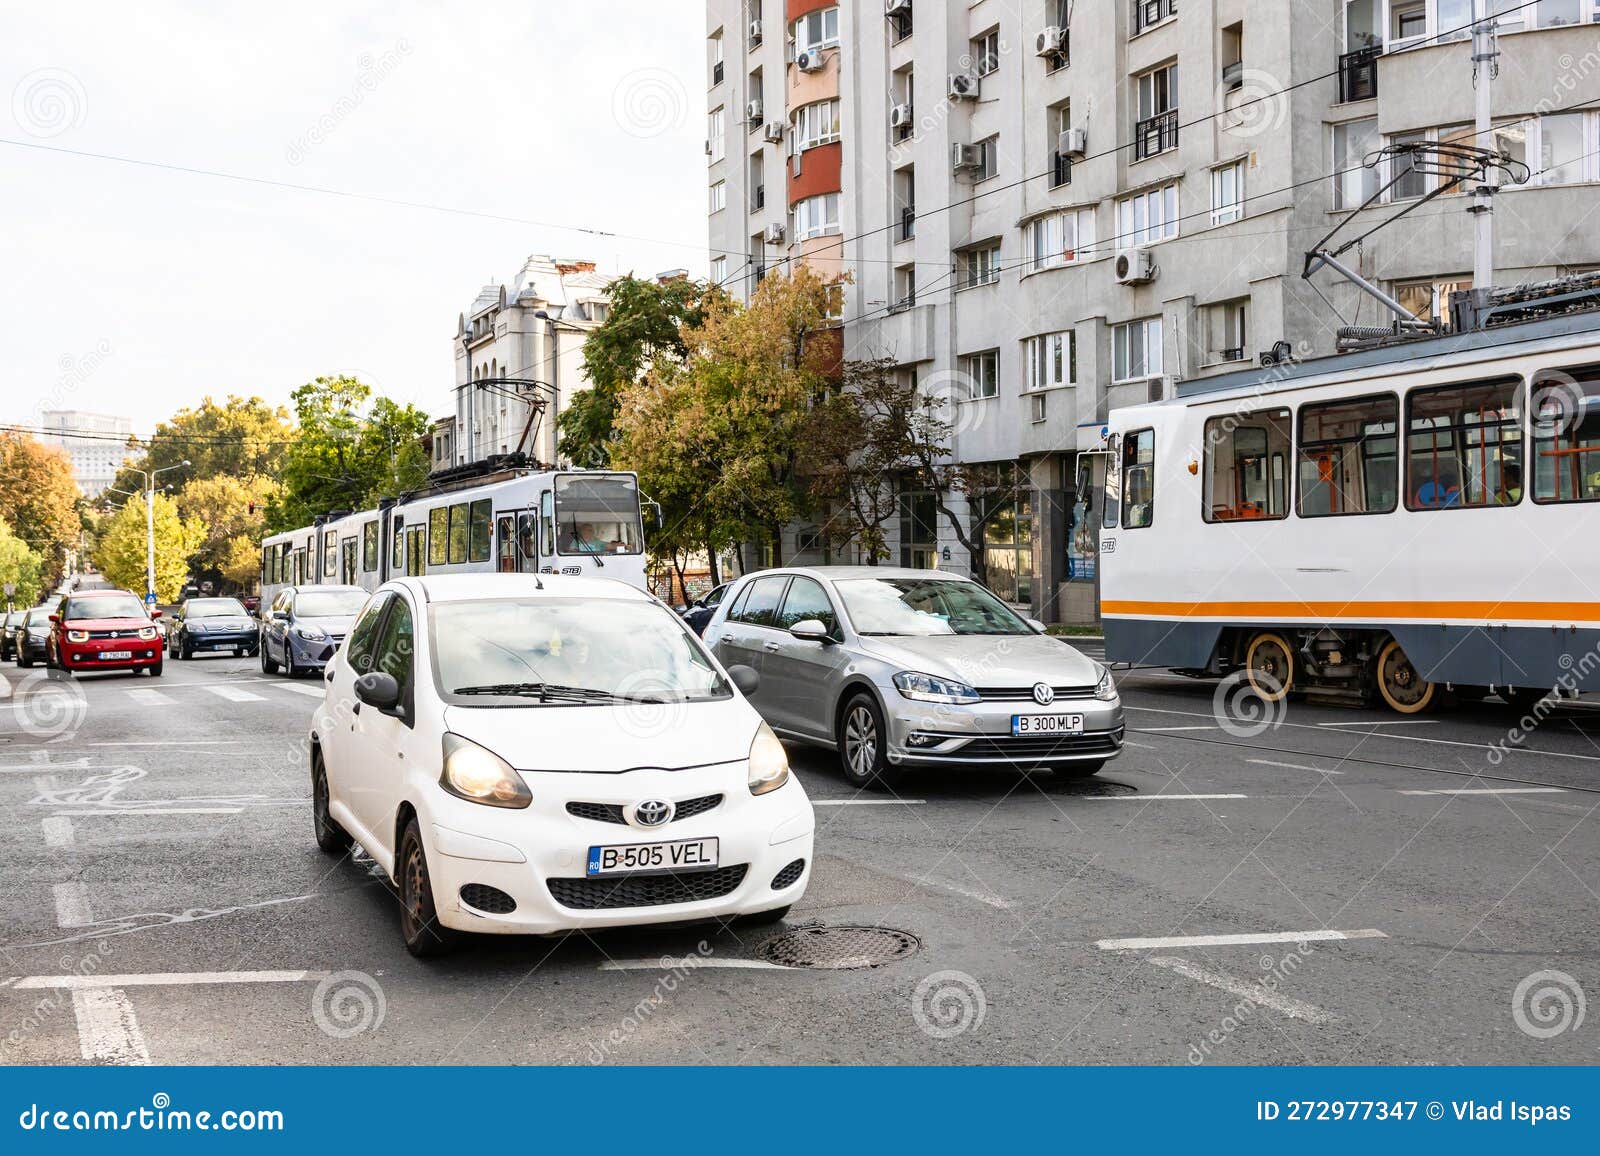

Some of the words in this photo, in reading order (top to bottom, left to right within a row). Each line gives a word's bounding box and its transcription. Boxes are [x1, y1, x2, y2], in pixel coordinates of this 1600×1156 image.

[1020, 717, 1029, 731] B
[1034, 716, 1056, 731] 300
[1057, 716, 1080, 730] MLP
[602, 849, 618, 869] B
[624, 846, 663, 867] 505
[670, 842, 711, 864] VEL
[589, 861, 599, 870] RO
